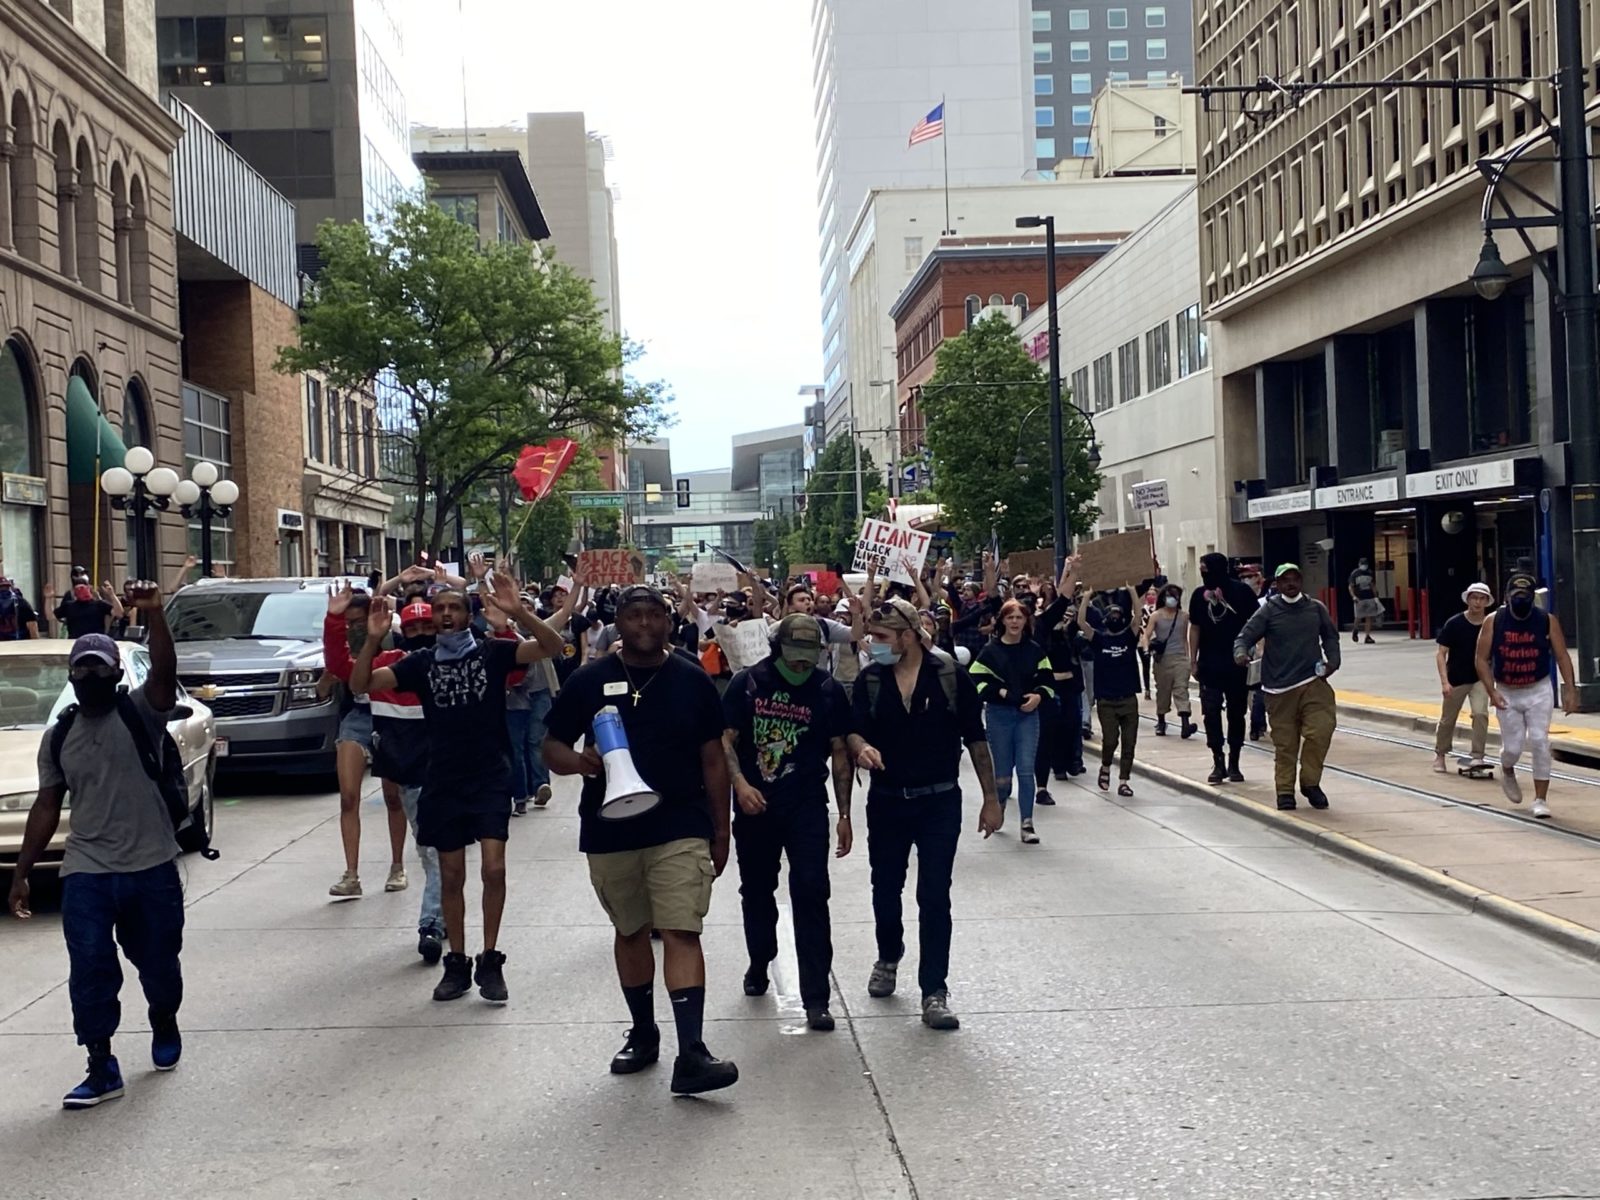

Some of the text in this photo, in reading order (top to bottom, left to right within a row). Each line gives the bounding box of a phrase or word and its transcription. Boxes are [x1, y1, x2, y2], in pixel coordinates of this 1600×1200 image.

[1436, 469, 1478, 490] EXIT ONLY
[593, 497, 611, 506] Street
[1337, 485, 1374, 504] ENTRANCE
[865, 522, 929, 553] I CAN'T
[580, 550, 632, 564] BLACK
[859, 540, 892, 557] BLACK
[856, 550, 887, 566] LIVES
[580, 560, 629, 574] IVES
[853, 560, 891, 577] MAER
